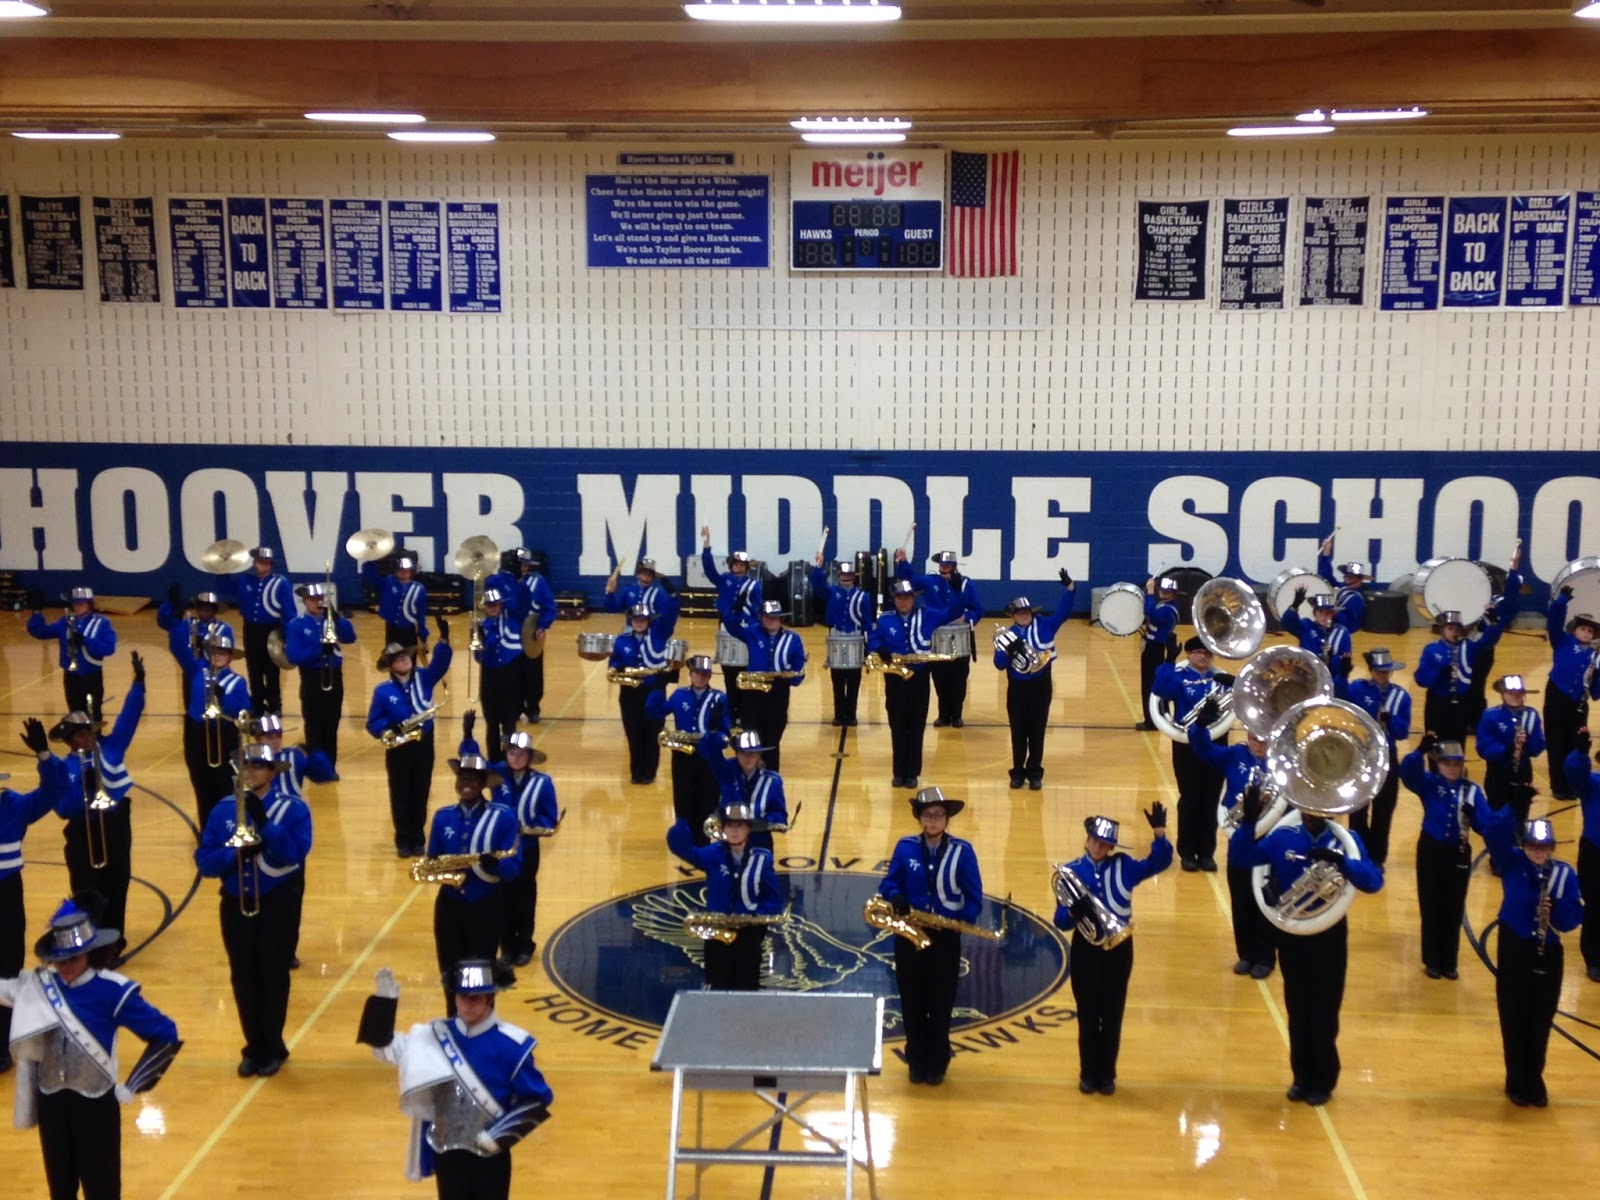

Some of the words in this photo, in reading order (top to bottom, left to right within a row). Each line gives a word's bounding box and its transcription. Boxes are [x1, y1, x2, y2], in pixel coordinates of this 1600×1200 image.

[682, 155, 703, 165] Fight
[706, 155, 726, 165] Song
[812, 152, 923, 196] meijer
[110, 200, 134, 208] BOYS
[1239, 202, 1275, 213] GIRLS
[1323, 199, 1351, 208] GIRLS
[1528, 198, 1552, 209] GIRLS
[94, 207, 151, 217] BASKETBALL
[656, 211, 673, 220] give
[687, 212, 703, 220] just
[1160, 206, 1187, 215] GIRLS
[1307, 207, 1367, 217] BASKETBALL
[1144, 215, 1202, 225] BASKETBALL
[1226, 213, 1286, 223] BASKETBALL
[1512, 211, 1567, 221] BASKETBALL
[232, 215, 264, 235] BACK
[663, 223, 682, 232] loyal
[1453, 213, 1500, 234] BACK
[1536, 222, 1564, 233] GRADE
[100, 226, 150, 234] CHAMPIONS
[800, 229, 832, 239] HAWKS
[904, 229, 933, 239] GUEST
[1147, 226, 1198, 236] CHAMPIONS
[1228, 224, 1280, 234] CHAMPIONS
[121, 234, 150, 243] GRADE
[681, 235, 698, 244] give
[1154, 236, 1166, 244] 7TH
[1170, 236, 1192, 244] GRADE
[1249, 235, 1280, 244] GRADE
[240, 243, 257, 263] TO
[655, 245, 681, 254] Taylor
[1228, 245, 1281, 254] 2000-2001
[1464, 242, 1486, 263] TO
[234, 271, 267, 290] BACK
[1450, 271, 1496, 292] BACK
[0, 467, 525, 579] HOOVER
[576, 473, 1093, 583] MIDDLE
[524, 994, 658, 1050] HOME
